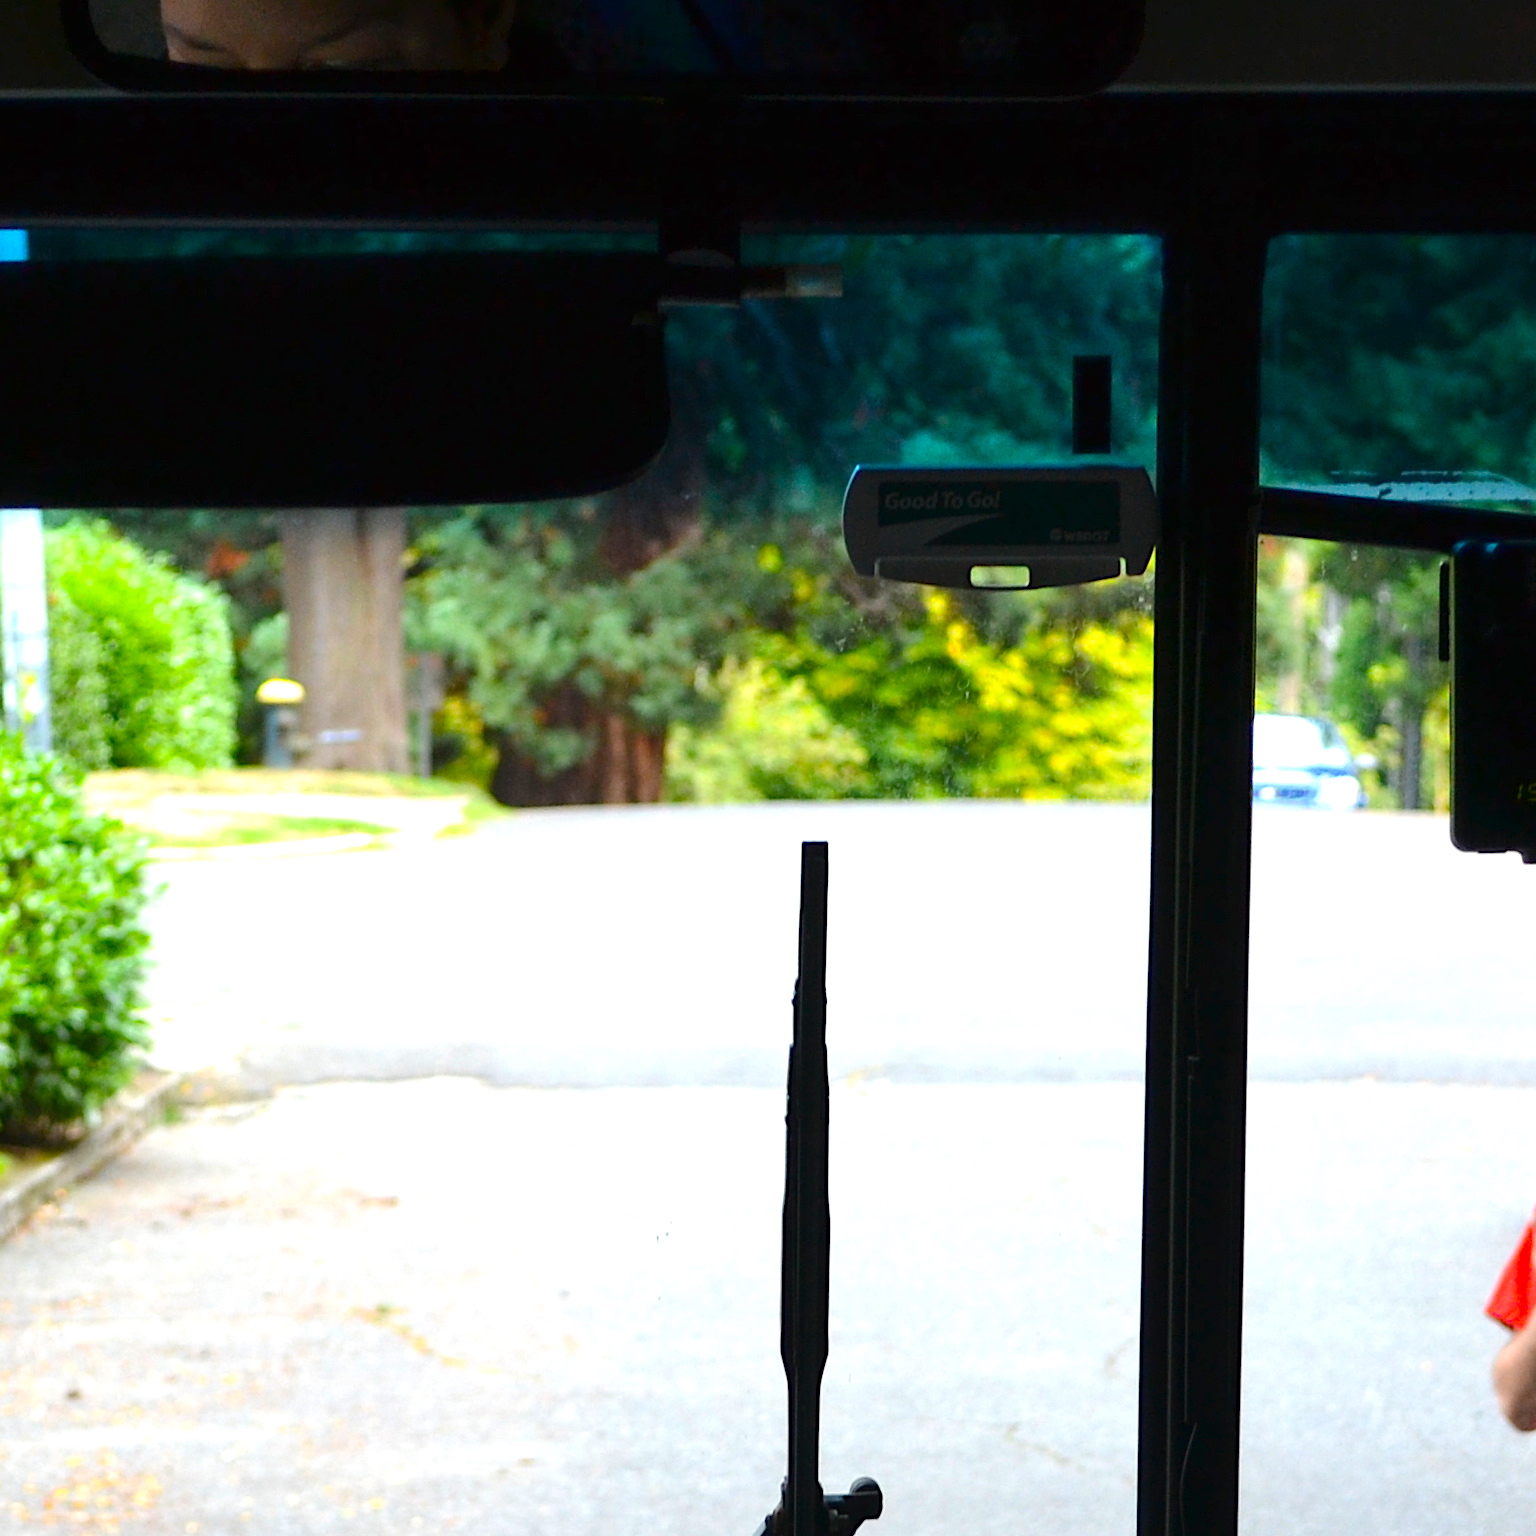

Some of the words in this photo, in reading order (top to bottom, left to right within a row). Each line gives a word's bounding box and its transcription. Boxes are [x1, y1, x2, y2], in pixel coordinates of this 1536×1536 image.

[884, 489, 940, 511] Good
[944, 489, 964, 510] To
[966, 489, 1001, 512] Go!
